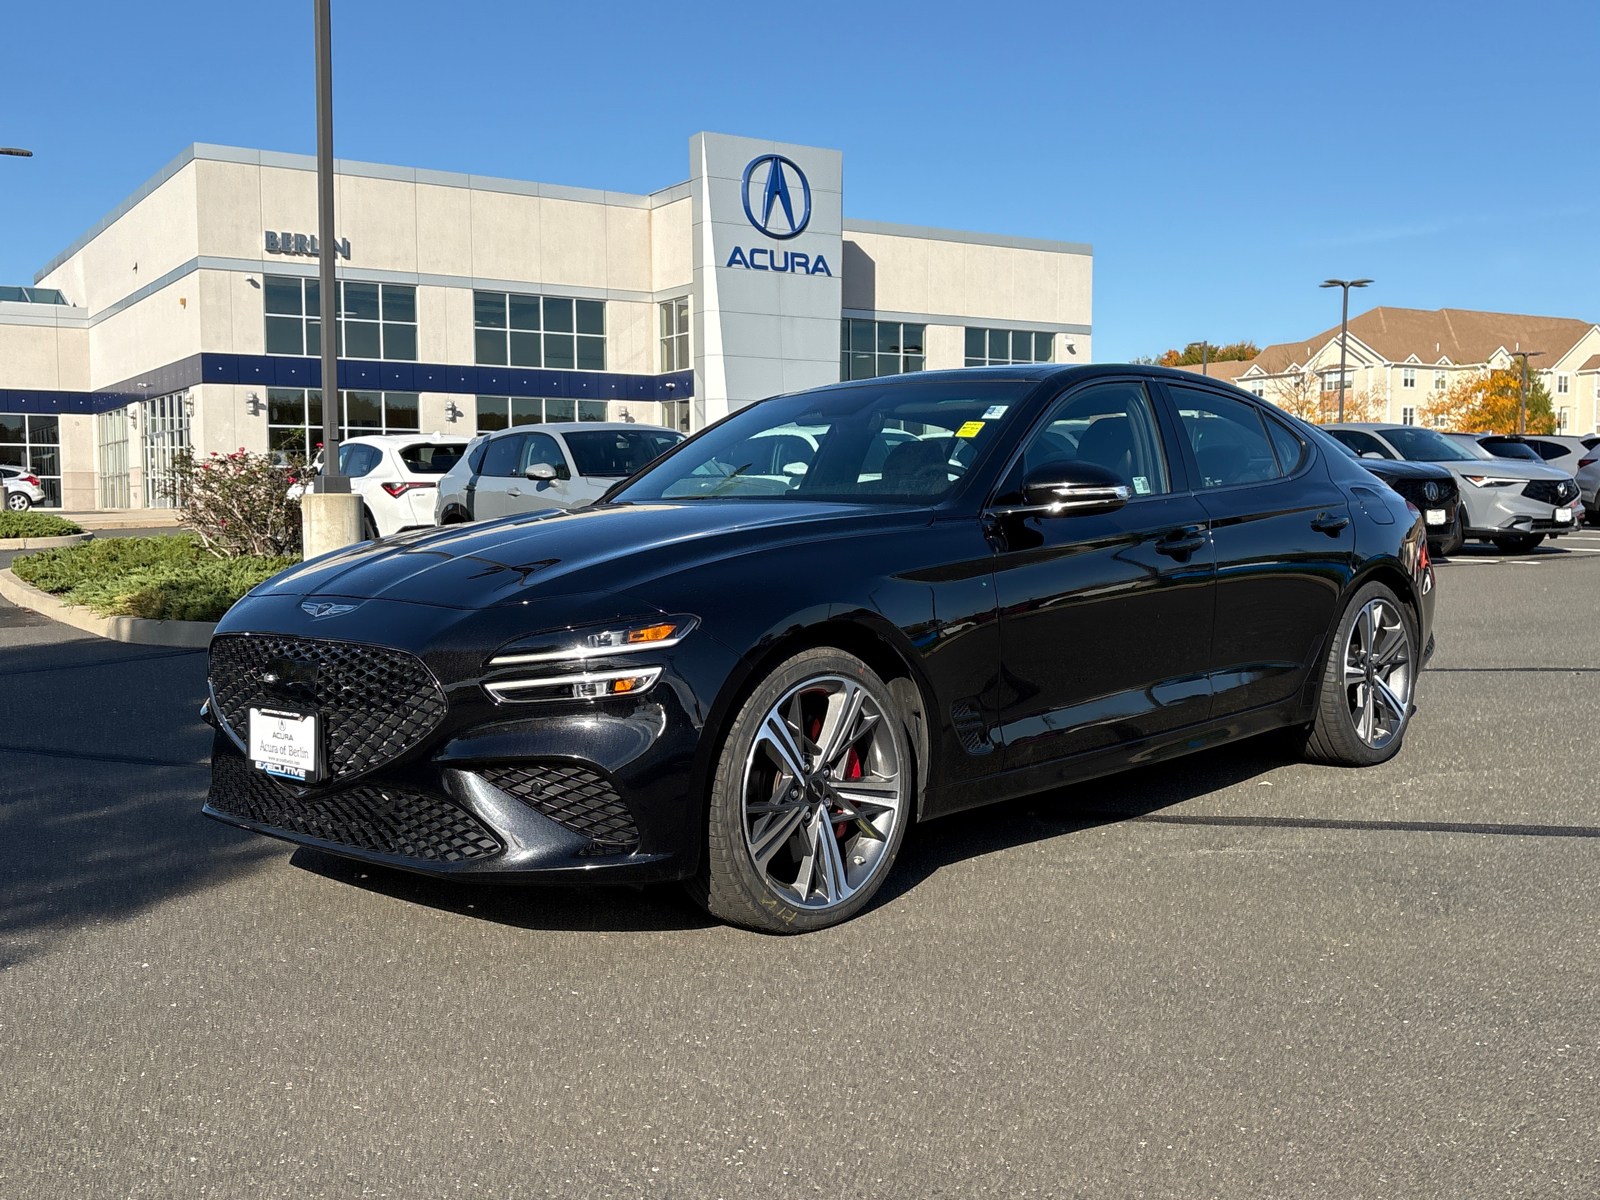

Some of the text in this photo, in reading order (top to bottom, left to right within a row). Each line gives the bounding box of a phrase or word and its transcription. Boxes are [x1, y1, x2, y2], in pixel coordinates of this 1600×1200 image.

[265, 231, 348, 257] BERLN
[726, 246, 832, 276] ACURA
[272, 731, 294, 741] ACURA
[260, 740, 309, 759] Acura of Berlin
[255, 761, 306, 777] EXECUTIVE
